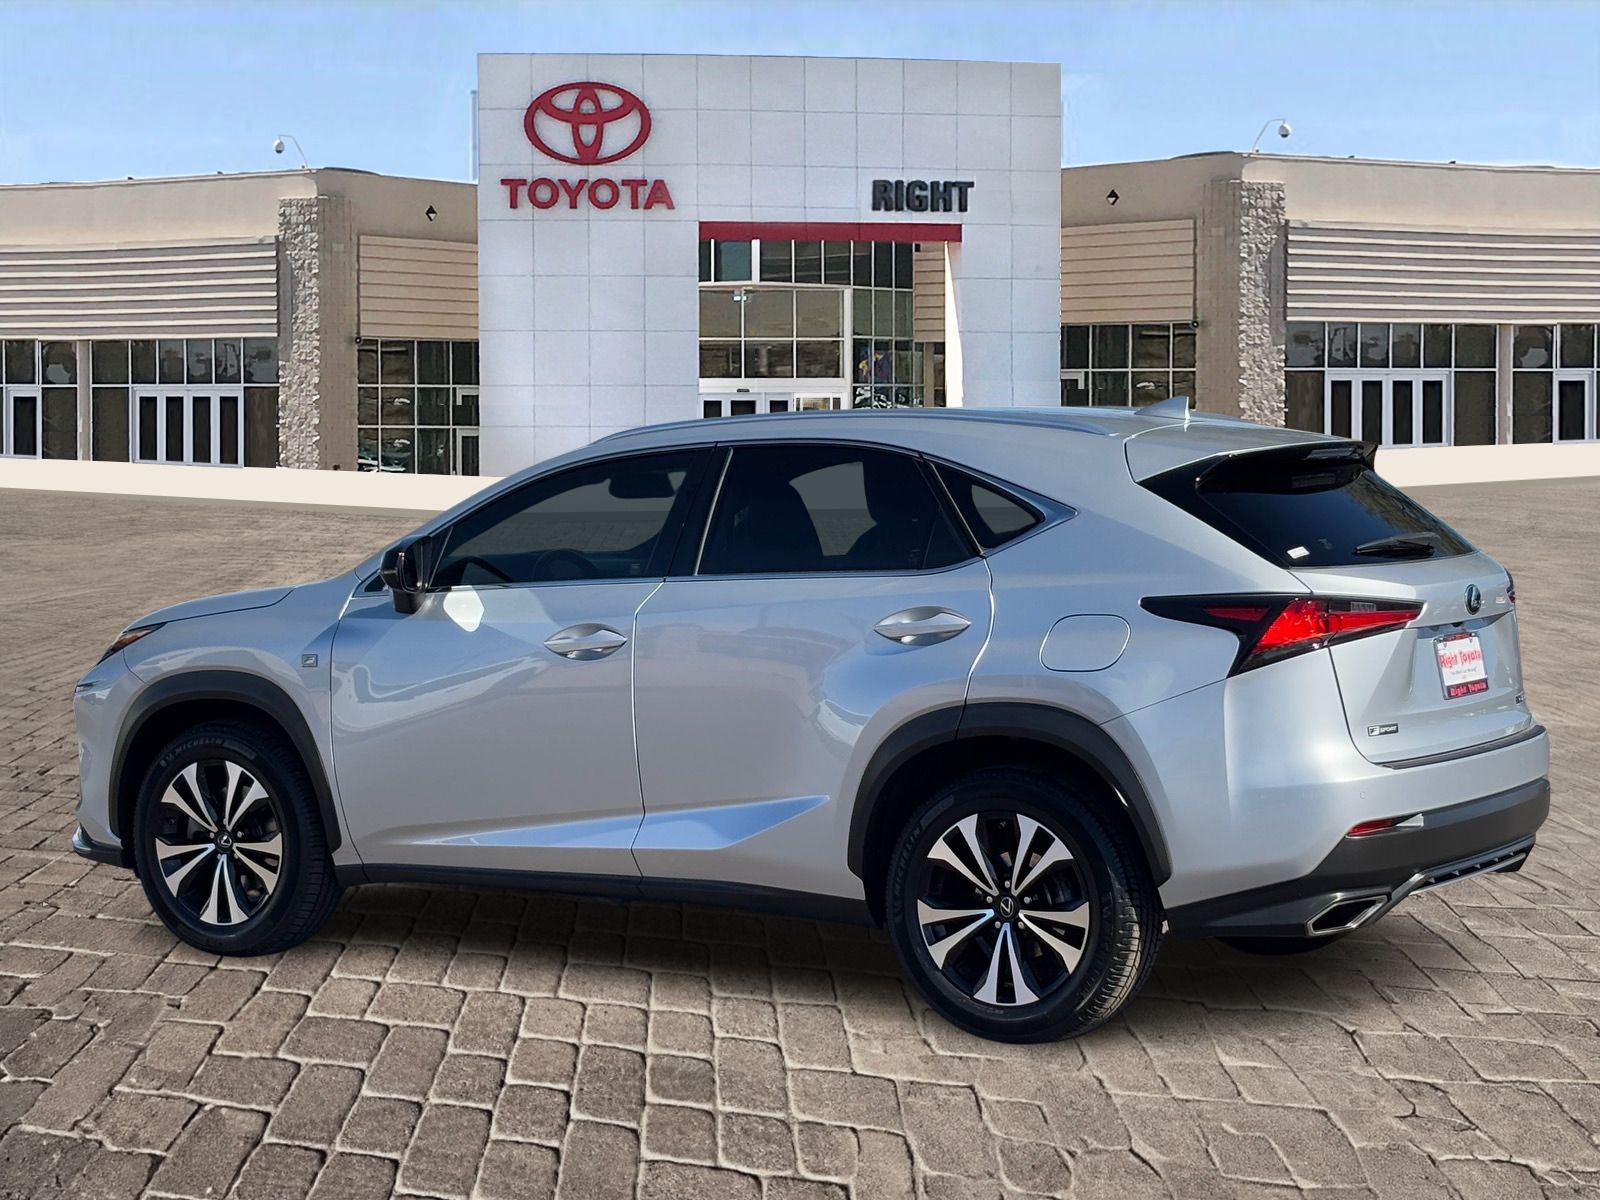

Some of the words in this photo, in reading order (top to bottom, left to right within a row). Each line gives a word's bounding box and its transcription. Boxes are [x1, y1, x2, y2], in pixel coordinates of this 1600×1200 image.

[500, 178, 675, 210] TOYOTA
[871, 179, 975, 213] RIGHT
[1439, 653, 1458, 669] Right
[1459, 649, 1481, 665] Toyota
[1450, 686, 1467, 696] Right
[1468, 682, 1487, 693] Toyota
